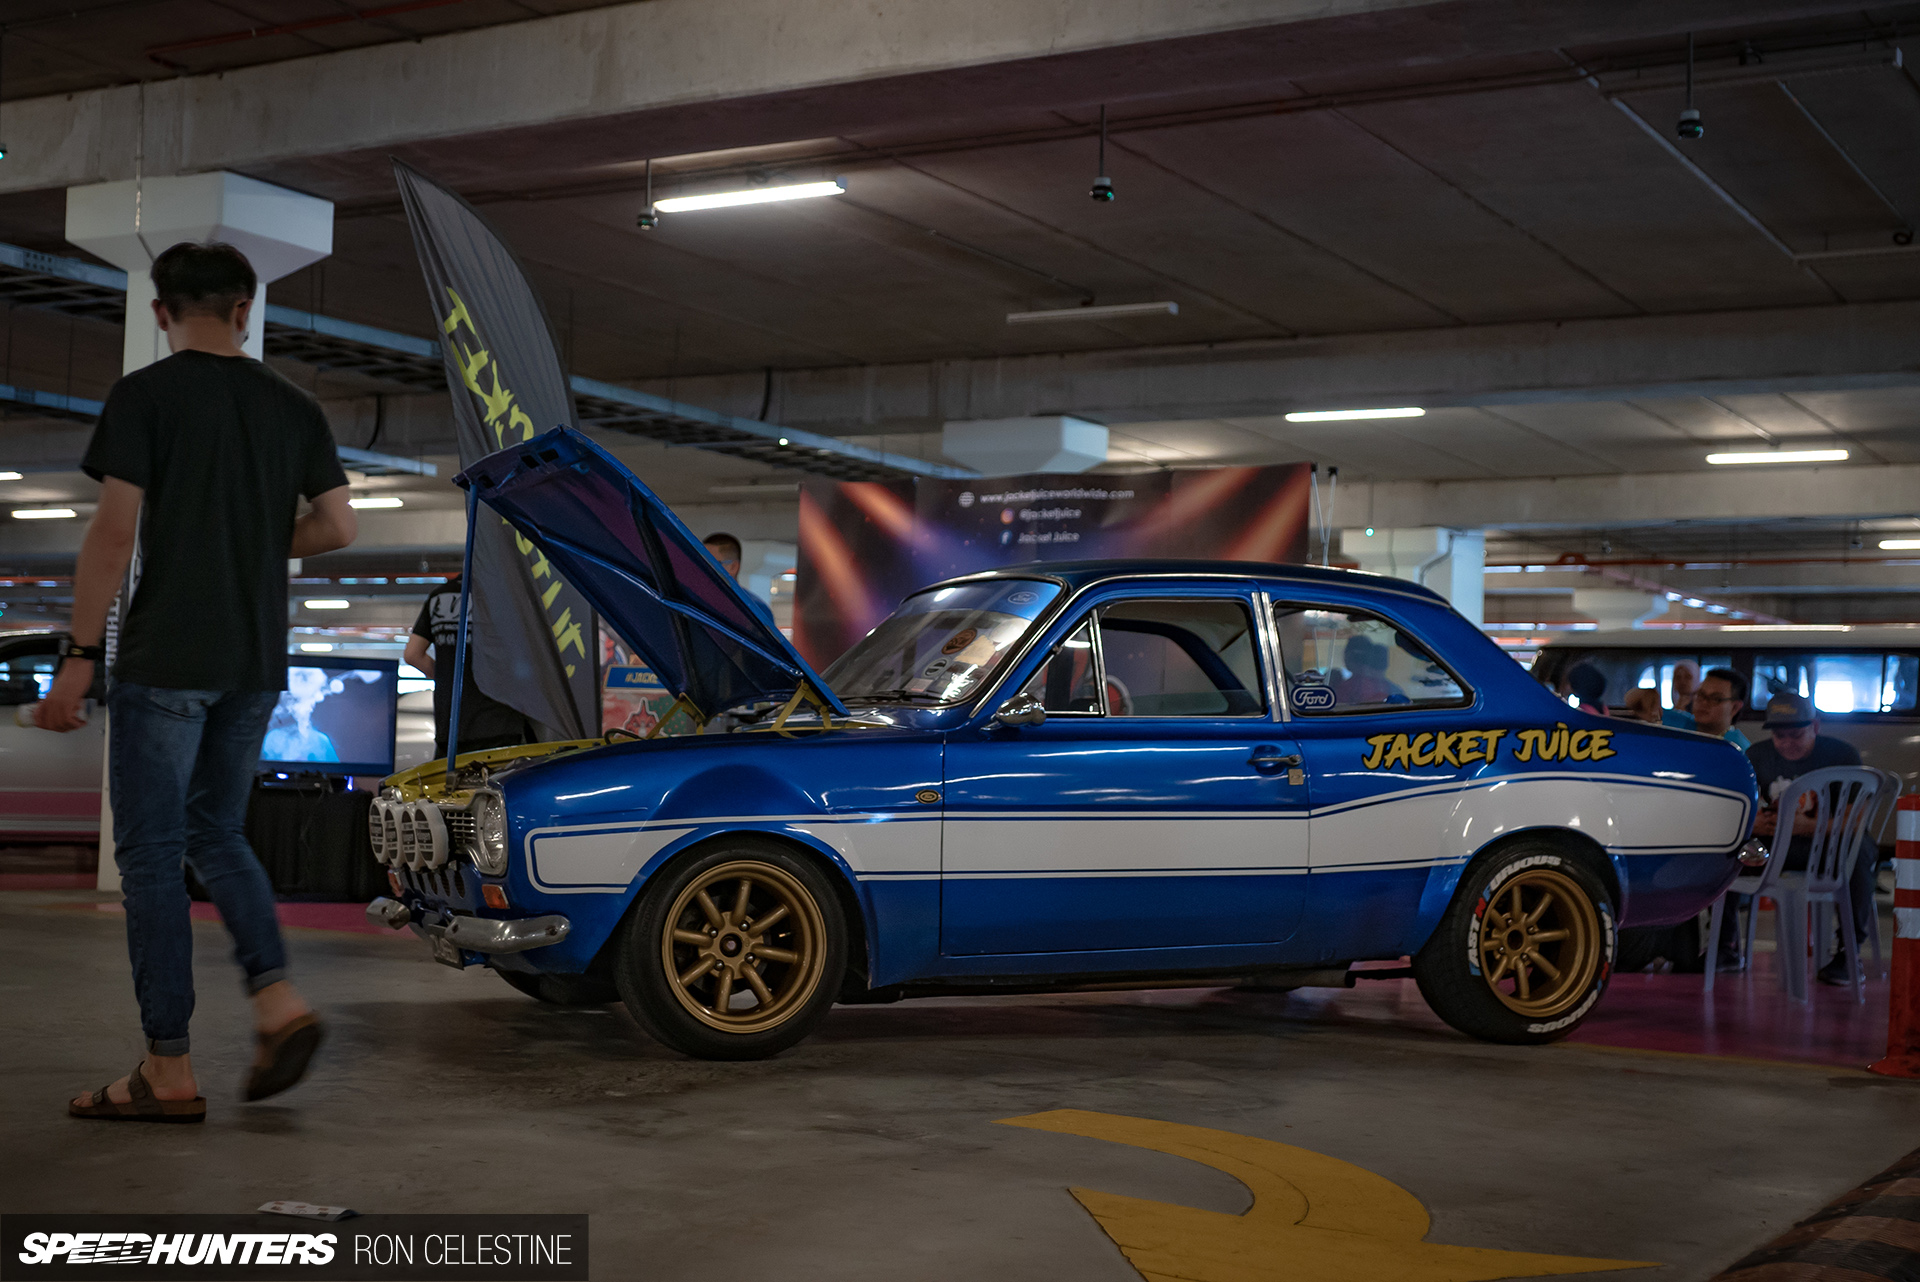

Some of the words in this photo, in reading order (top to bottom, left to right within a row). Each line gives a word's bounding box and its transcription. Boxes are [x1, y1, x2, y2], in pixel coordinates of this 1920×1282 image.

[1296, 690, 1330, 706] Ford
[1362, 729, 1507, 769] JACKET
[1513, 722, 1617, 762] JUICE
